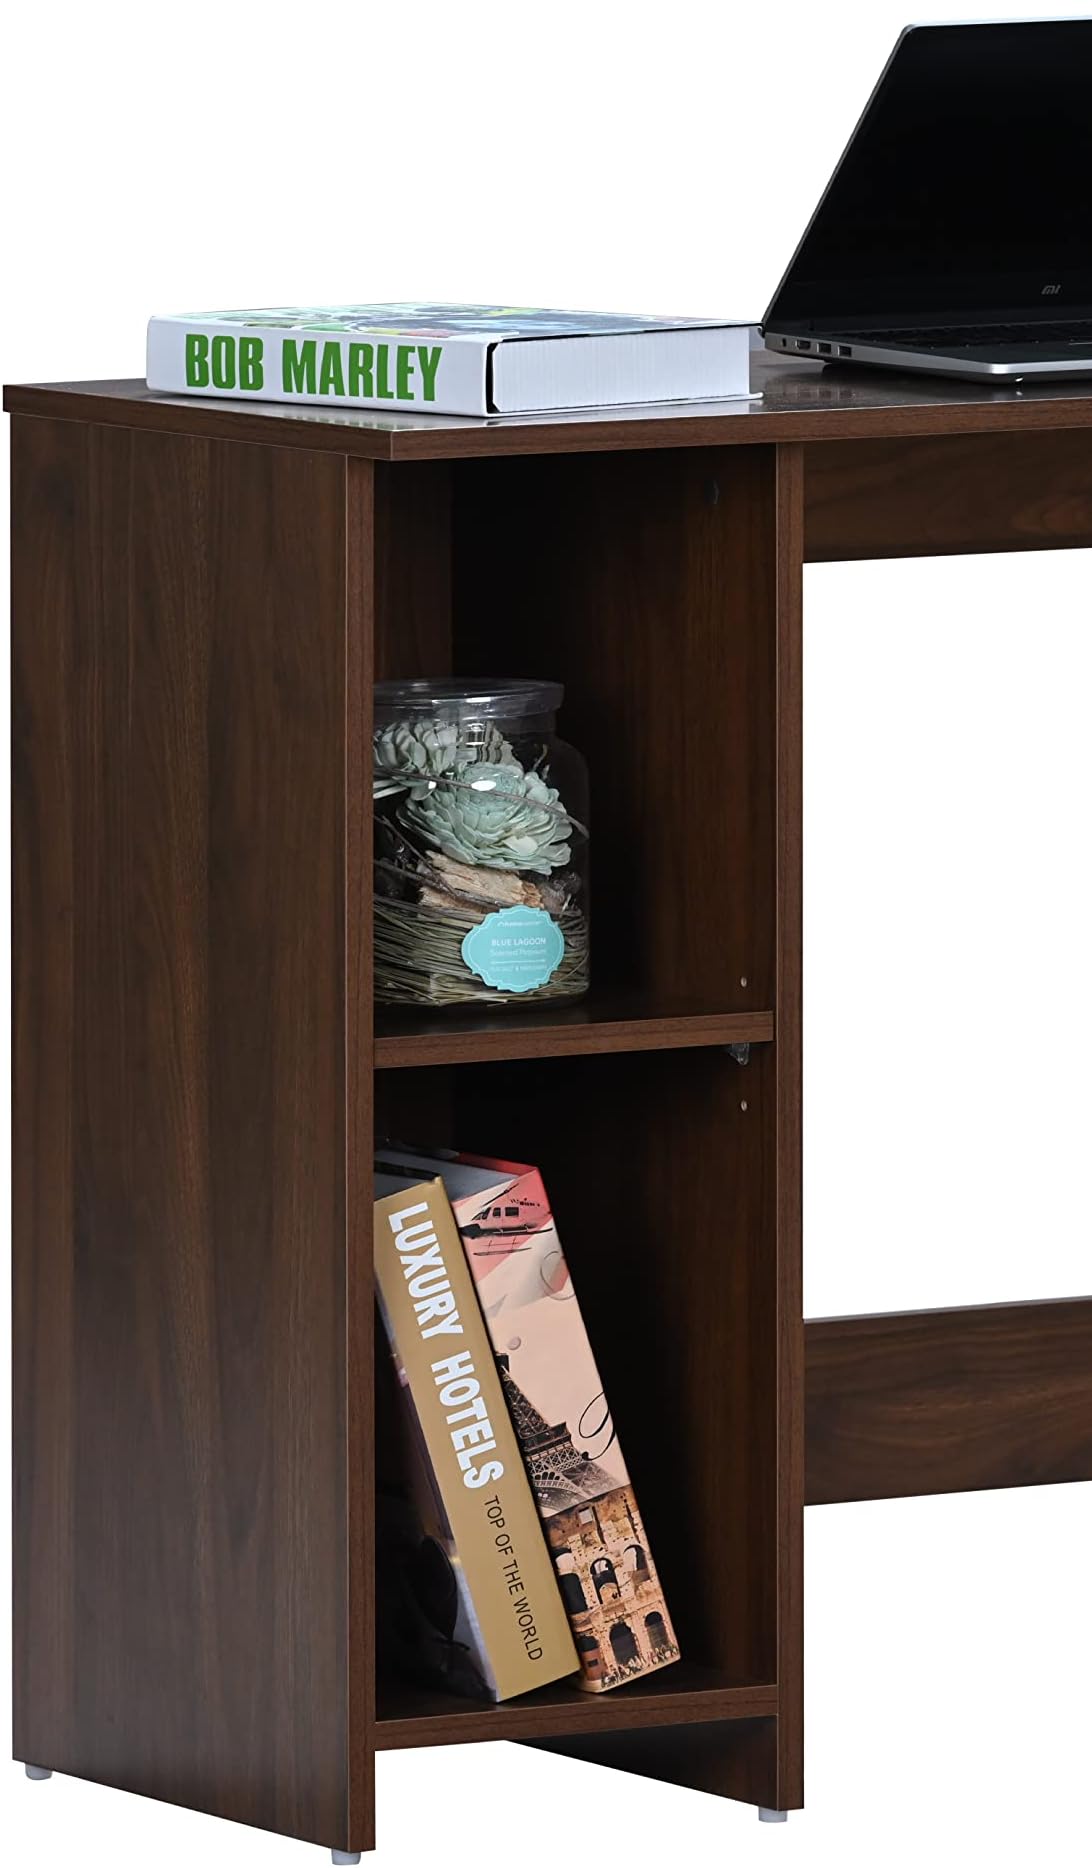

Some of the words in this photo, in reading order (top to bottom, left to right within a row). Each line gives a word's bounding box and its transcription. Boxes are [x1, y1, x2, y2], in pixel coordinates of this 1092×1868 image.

[185, 334, 265, 392] BOB
[282, 338, 443, 402] MARLEY
[491, 938, 512, 947] BLUE
[513, 937, 547, 946] LAGOON
[388, 1201, 464, 1340] LUXURY
[430, 1350, 505, 1489] HOTELS
[484, 1495, 505, 1529] TOP
[495, 1533, 514, 1556] OF
[503, 1559, 525, 1596] THE
[513, 1597, 543, 1661] WORLD
